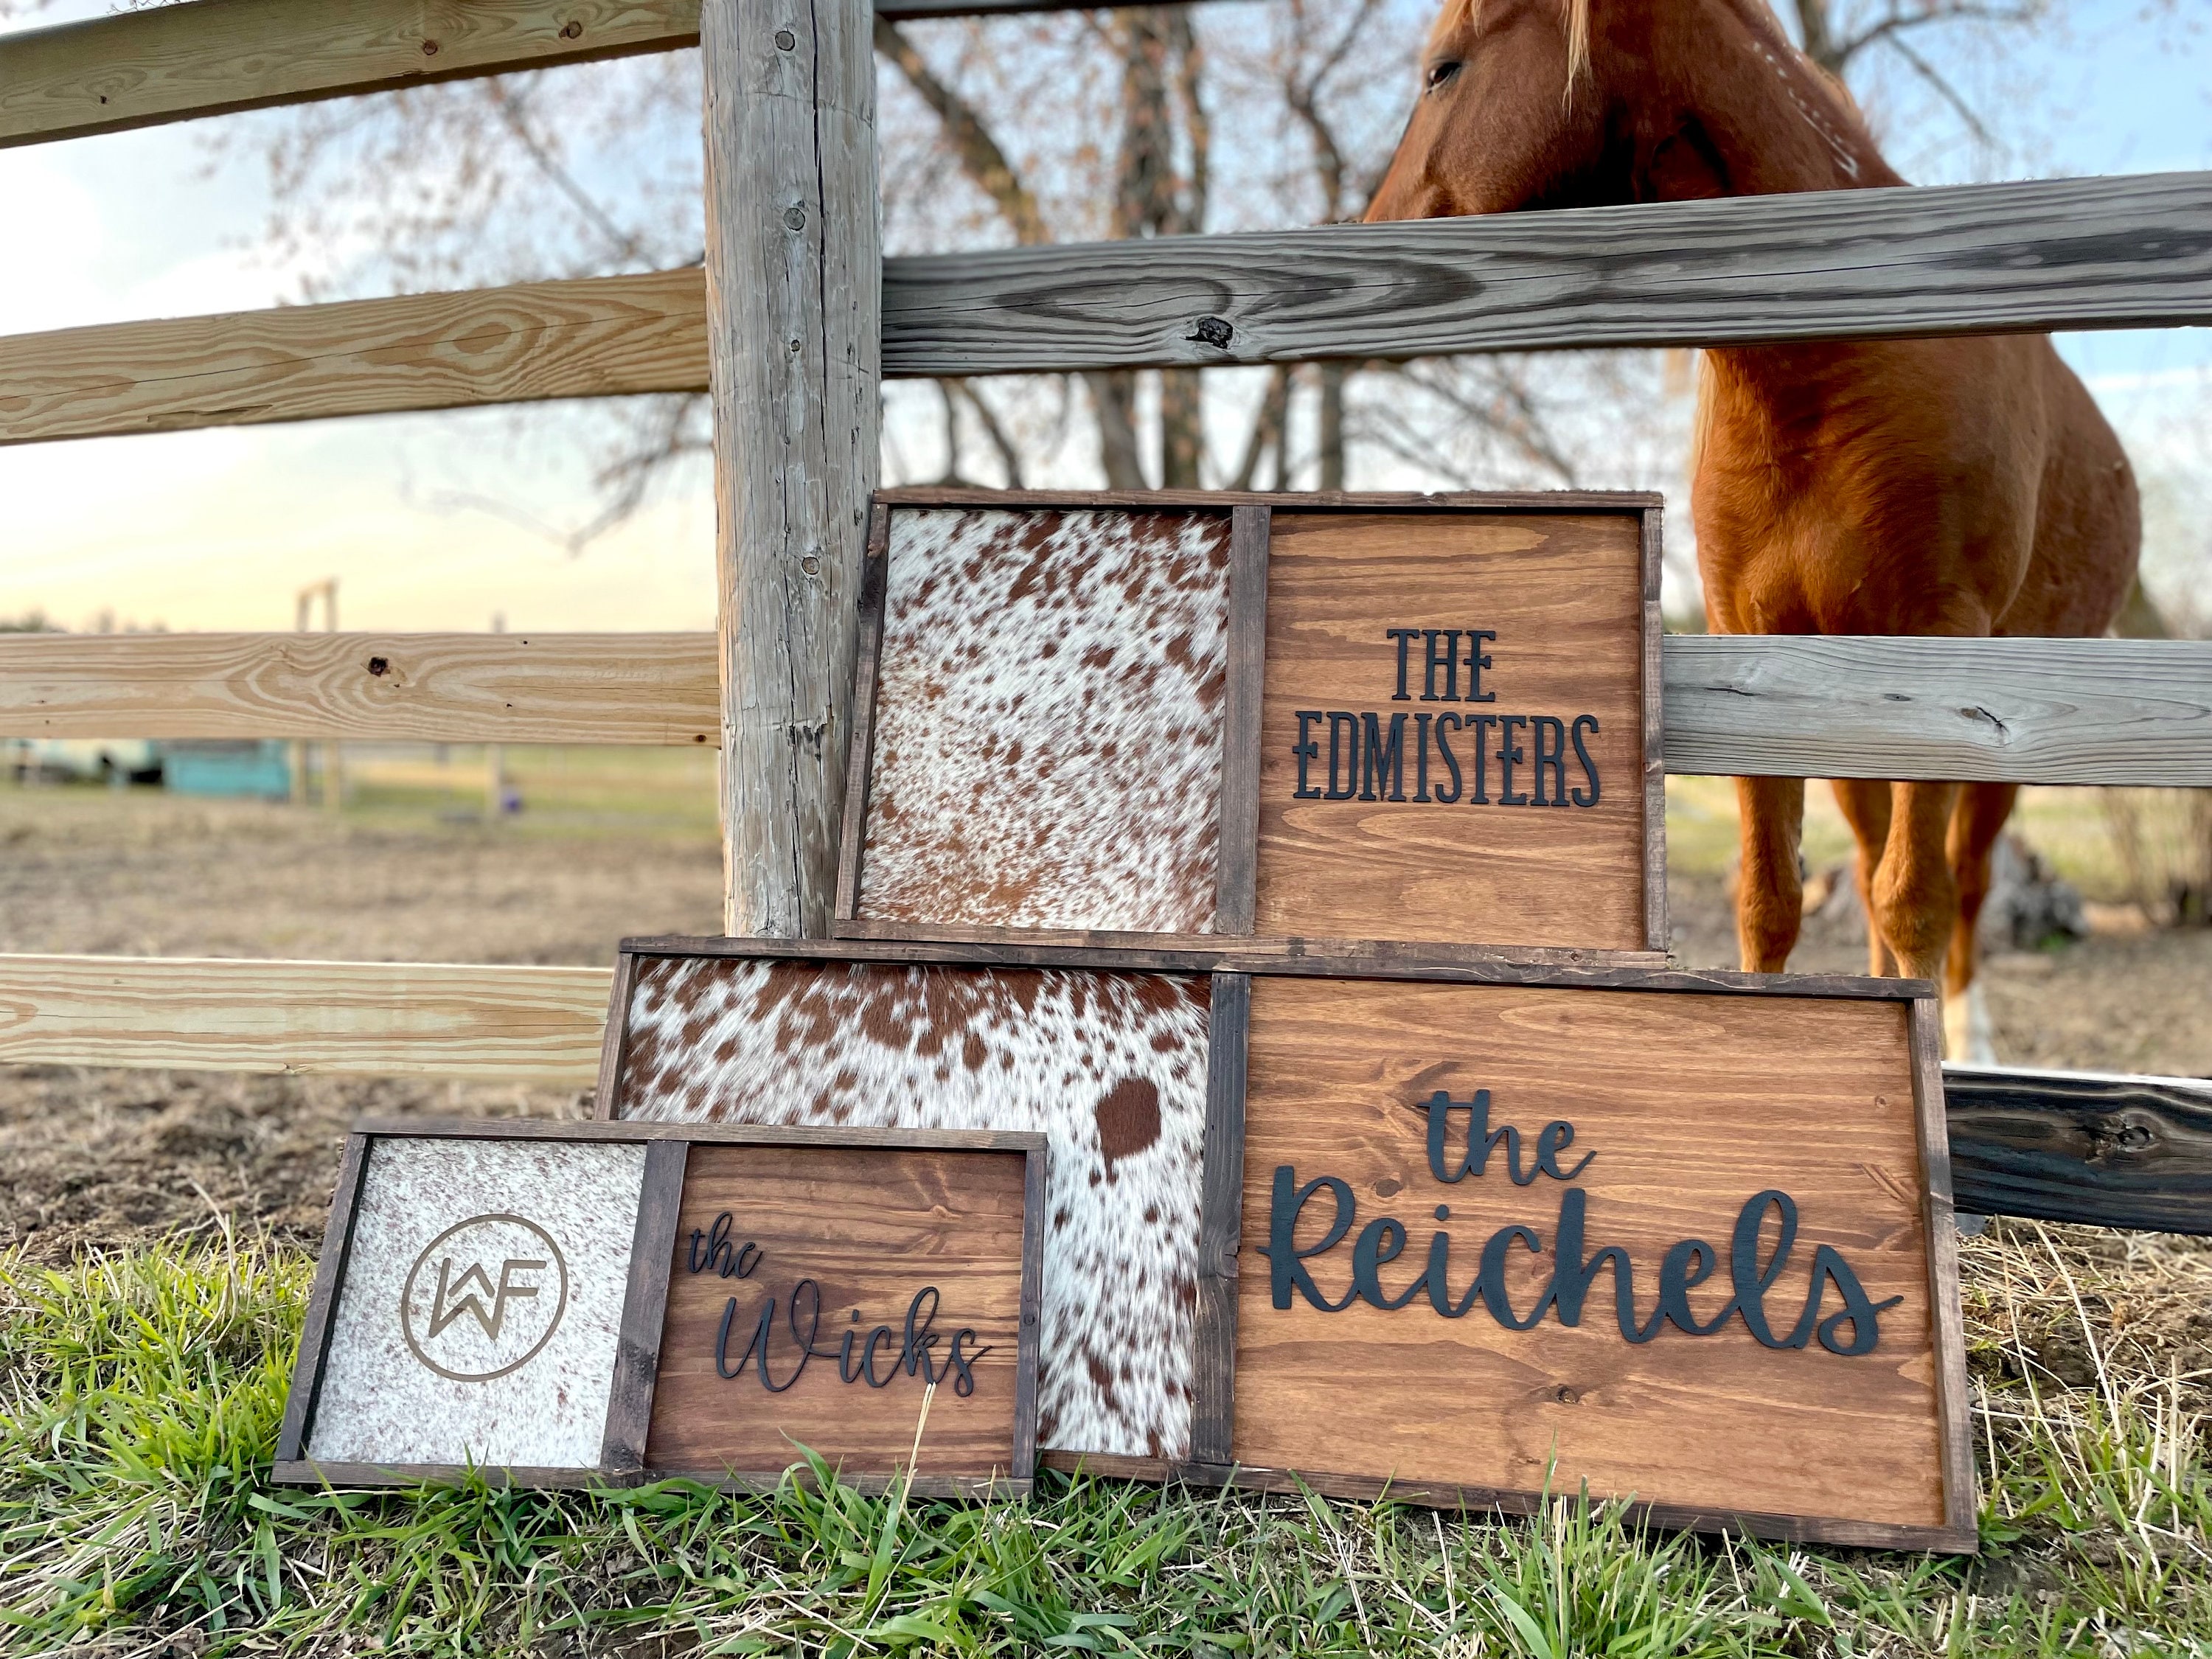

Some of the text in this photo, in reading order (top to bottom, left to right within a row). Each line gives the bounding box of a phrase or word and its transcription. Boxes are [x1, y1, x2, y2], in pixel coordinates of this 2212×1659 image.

[1386, 629, 1496, 702] THE
[1292, 710, 1601, 807] EDMISTERS
[1416, 1088, 1598, 1186] the
[689, 1211, 763, 1279] the
[1256, 1164, 1905, 1356] Reichels
[715, 1278, 993, 1397] Wicks
